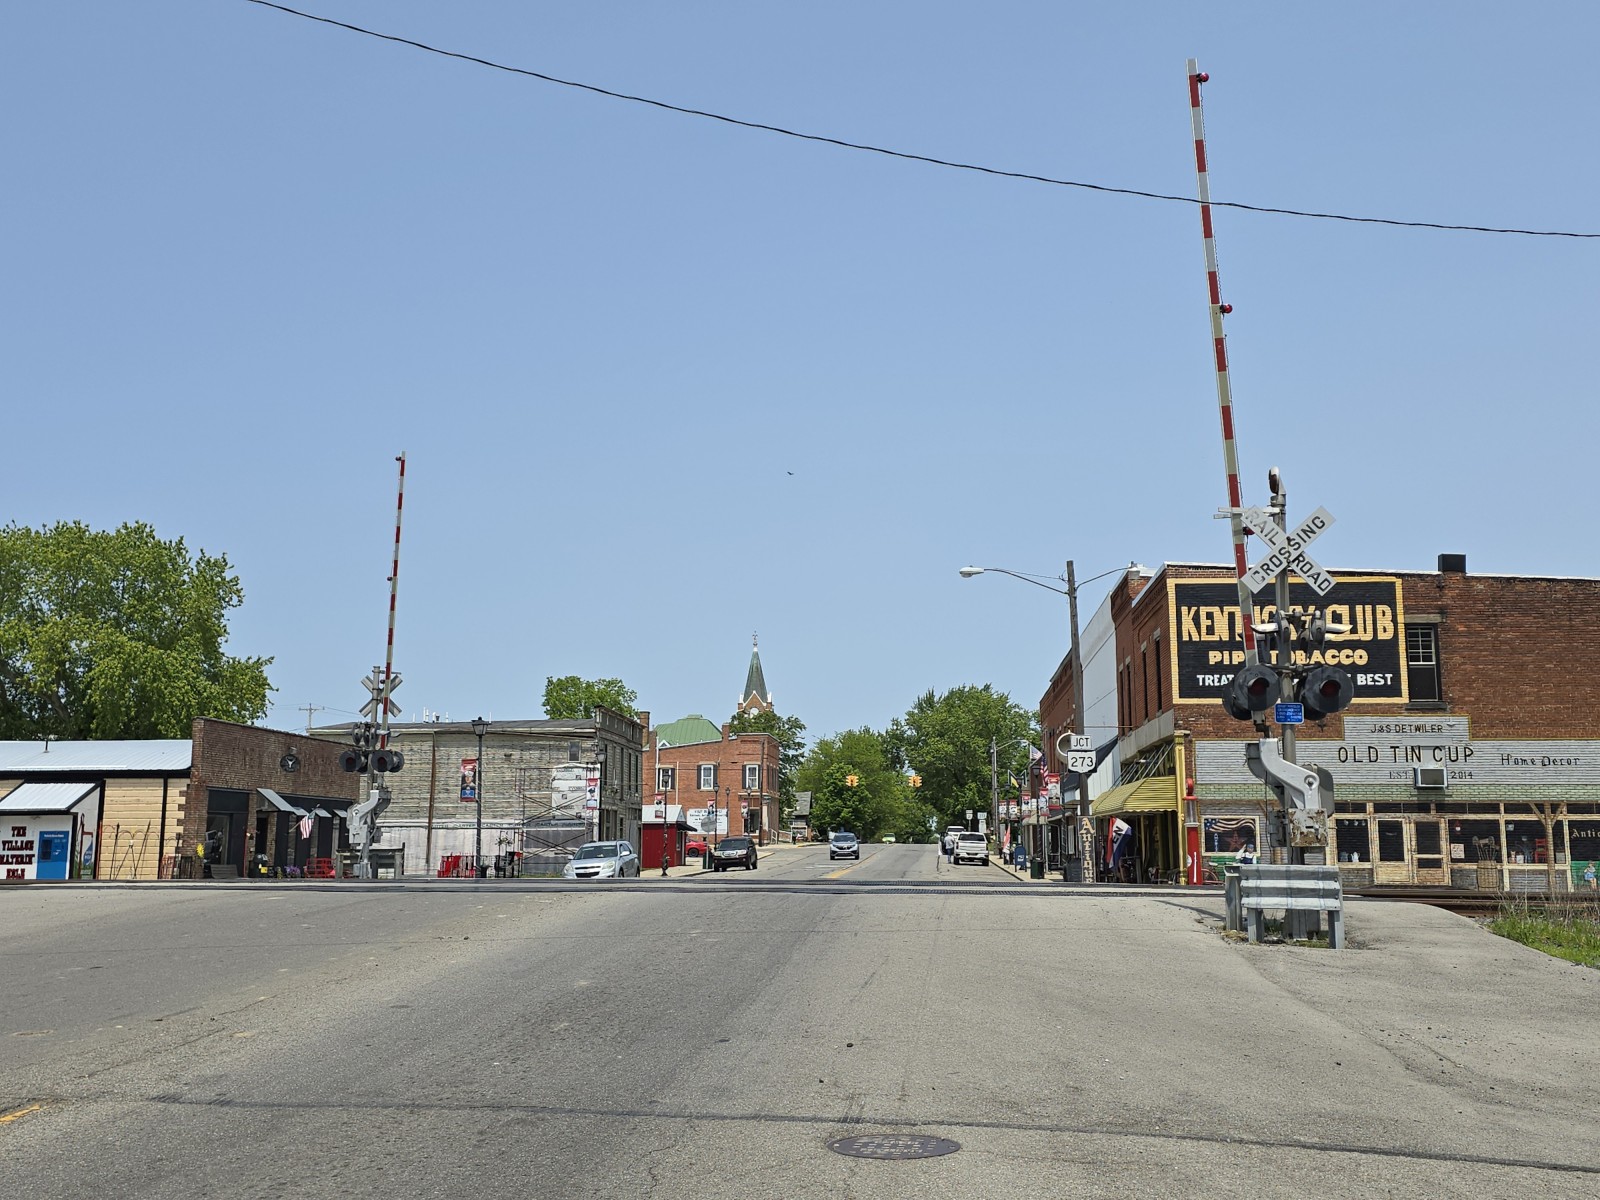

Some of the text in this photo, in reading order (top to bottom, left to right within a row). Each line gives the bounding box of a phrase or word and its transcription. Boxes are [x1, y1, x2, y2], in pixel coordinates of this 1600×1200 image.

[1245, 510, 1332, 592] RAIL ROAD
[1250, 515, 1326, 585] CROSSING
[1326, 604, 1395, 641] CLUB
[1208, 650, 1246, 665] PIP
[1357, 673, 1393, 686] BEST
[1370, 724, 1444, 734] J&S DETWILER
[1073, 737, 1090, 748] JCT
[1338, 745, 1474, 763] OLD TIN CUP
[1501, 753, 1580, 767] Home Decor
[1070, 756, 1094, 768] 273
[1450, 771, 1474, 780] 2014
[12, 826, 26, 837] THE
[2, 840, 34, 851] VILLAGE
